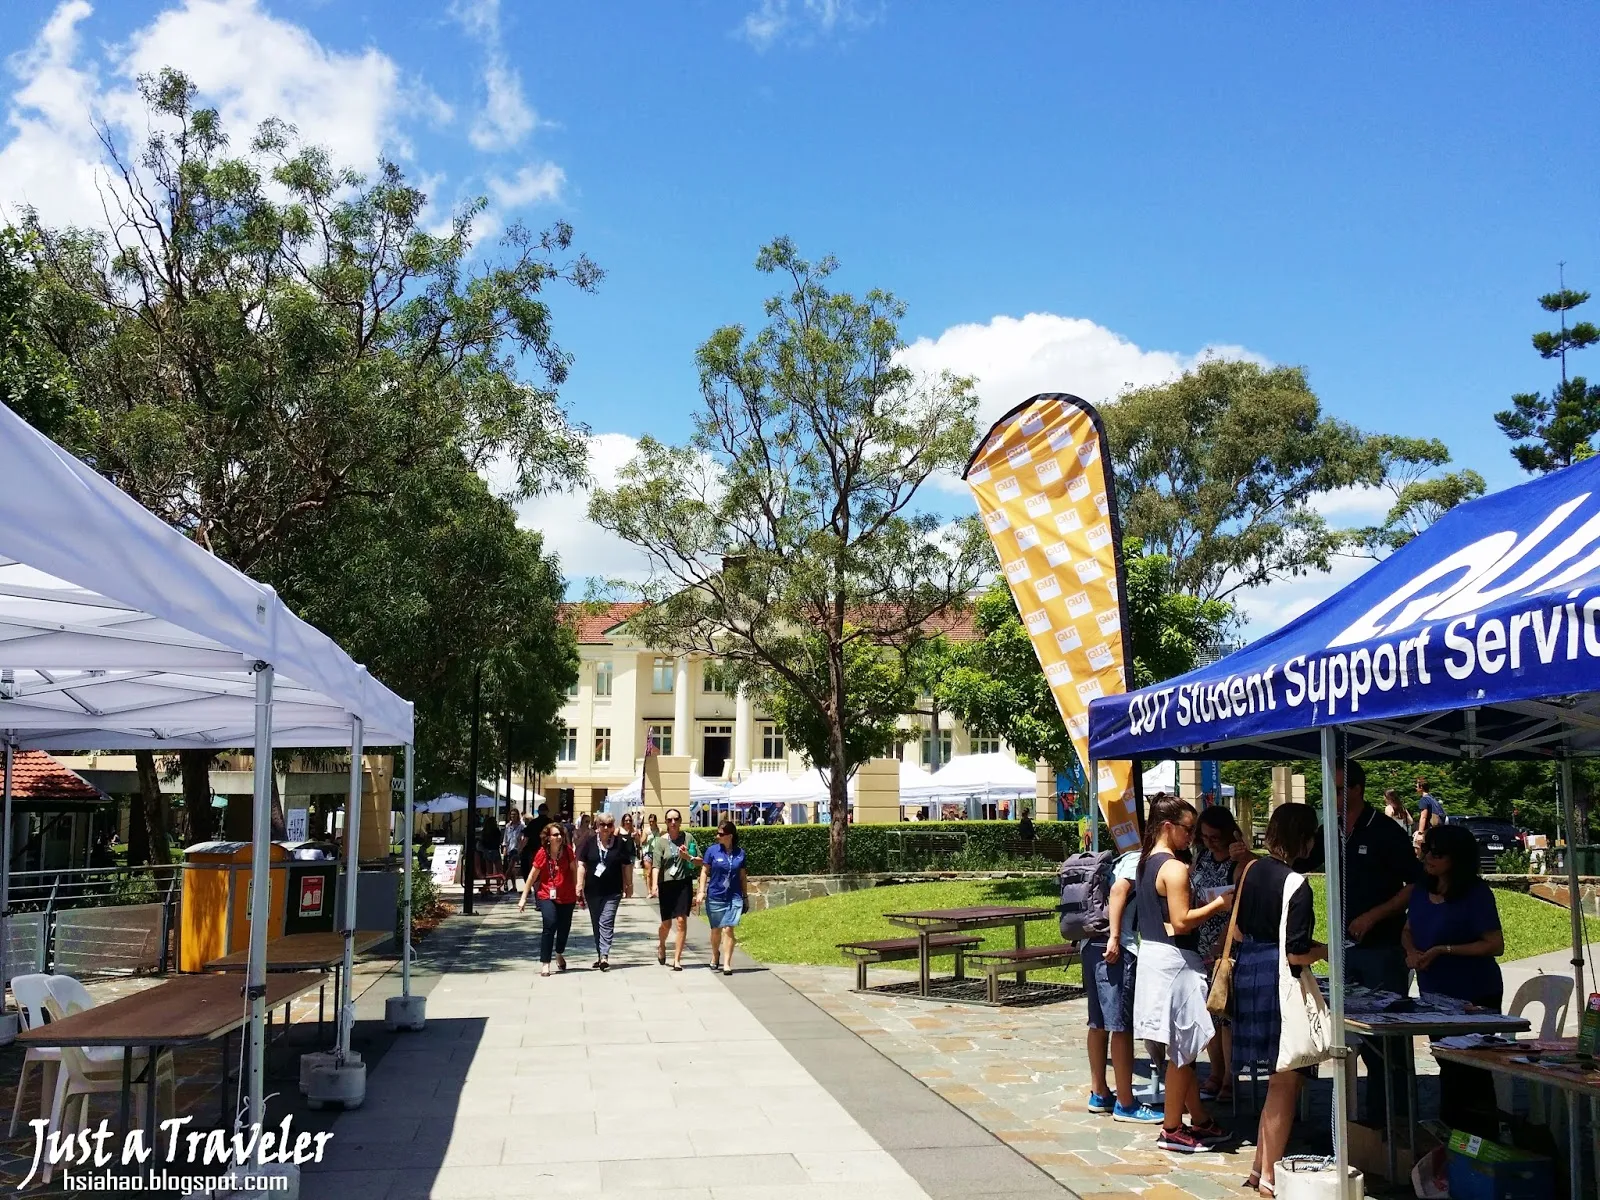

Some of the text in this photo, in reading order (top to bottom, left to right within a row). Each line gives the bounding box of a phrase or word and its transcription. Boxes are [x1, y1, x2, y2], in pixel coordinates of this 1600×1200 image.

[1008, 443, 1027, 458] QUT
[1078, 441, 1096, 456] QUT
[1037, 460, 1056, 474] QUT
[997, 477, 1016, 491] QUT
[1068, 476, 1087, 490] QUT
[1027, 494, 1046, 508] QUT
[1057, 510, 1076, 524] QUT
[1016, 527, 1036, 539] QUT
[1087, 526, 1107, 540] QUT
[1045, 543, 1065, 556] QUT
[1006, 560, 1026, 574] QUT
[1077, 559, 1097, 572] QUT
[1037, 577, 1057, 590] QUT
[1067, 593, 1087, 607] QUT
[1026, 610, 1046, 624] QUT
[1098, 611, 1118, 624] QUT
[1057, 629, 1076, 641] QUT
[1088, 646, 1107, 659] QUT
[1048, 664, 1067, 676] QUT
[1079, 681, 1098, 694] QUT
[1129, 687, 1175, 735] QUT
[1177, 664, 1277, 726] Student
[1284, 626, 1431, 715] Support
[1114, 822, 1133, 836] QUT
